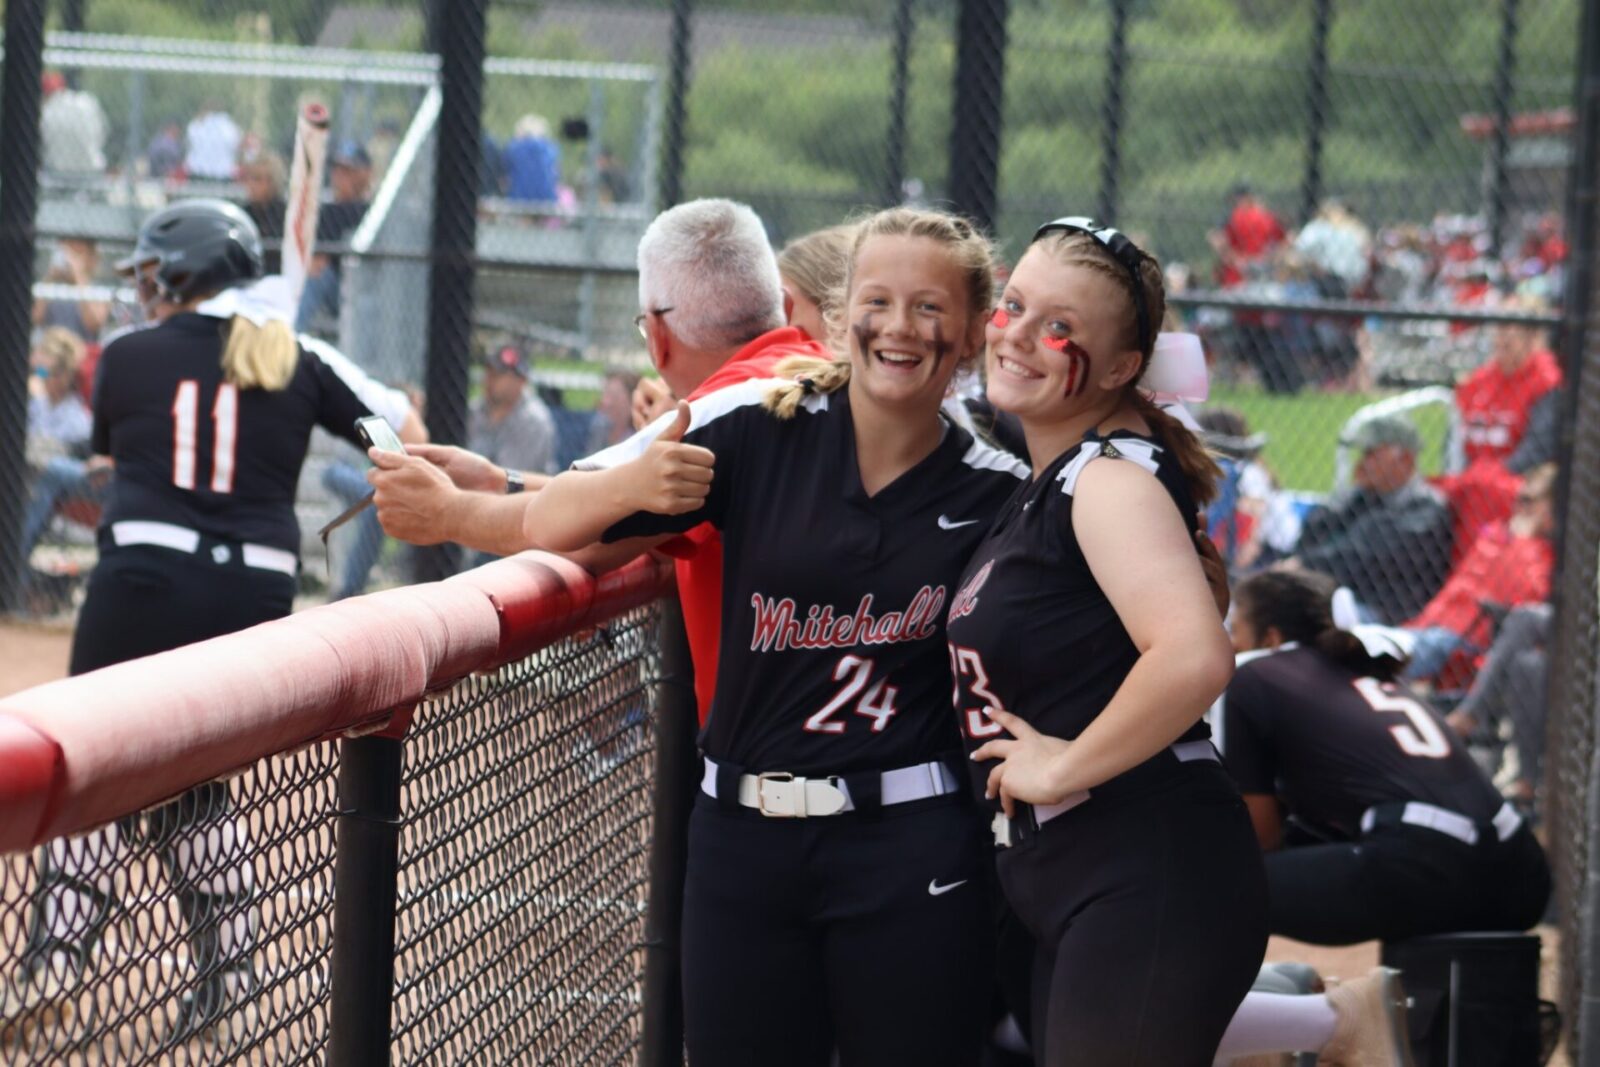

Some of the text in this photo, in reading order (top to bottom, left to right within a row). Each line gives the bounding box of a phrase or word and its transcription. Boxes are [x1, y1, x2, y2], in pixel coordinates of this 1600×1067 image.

[171, 379, 238, 494] 11
[751, 585, 946, 652] Whitehall
[803, 654, 898, 733] 24
[948, 640, 1004, 738] 3
[1351, 676, 1452, 758] 5
